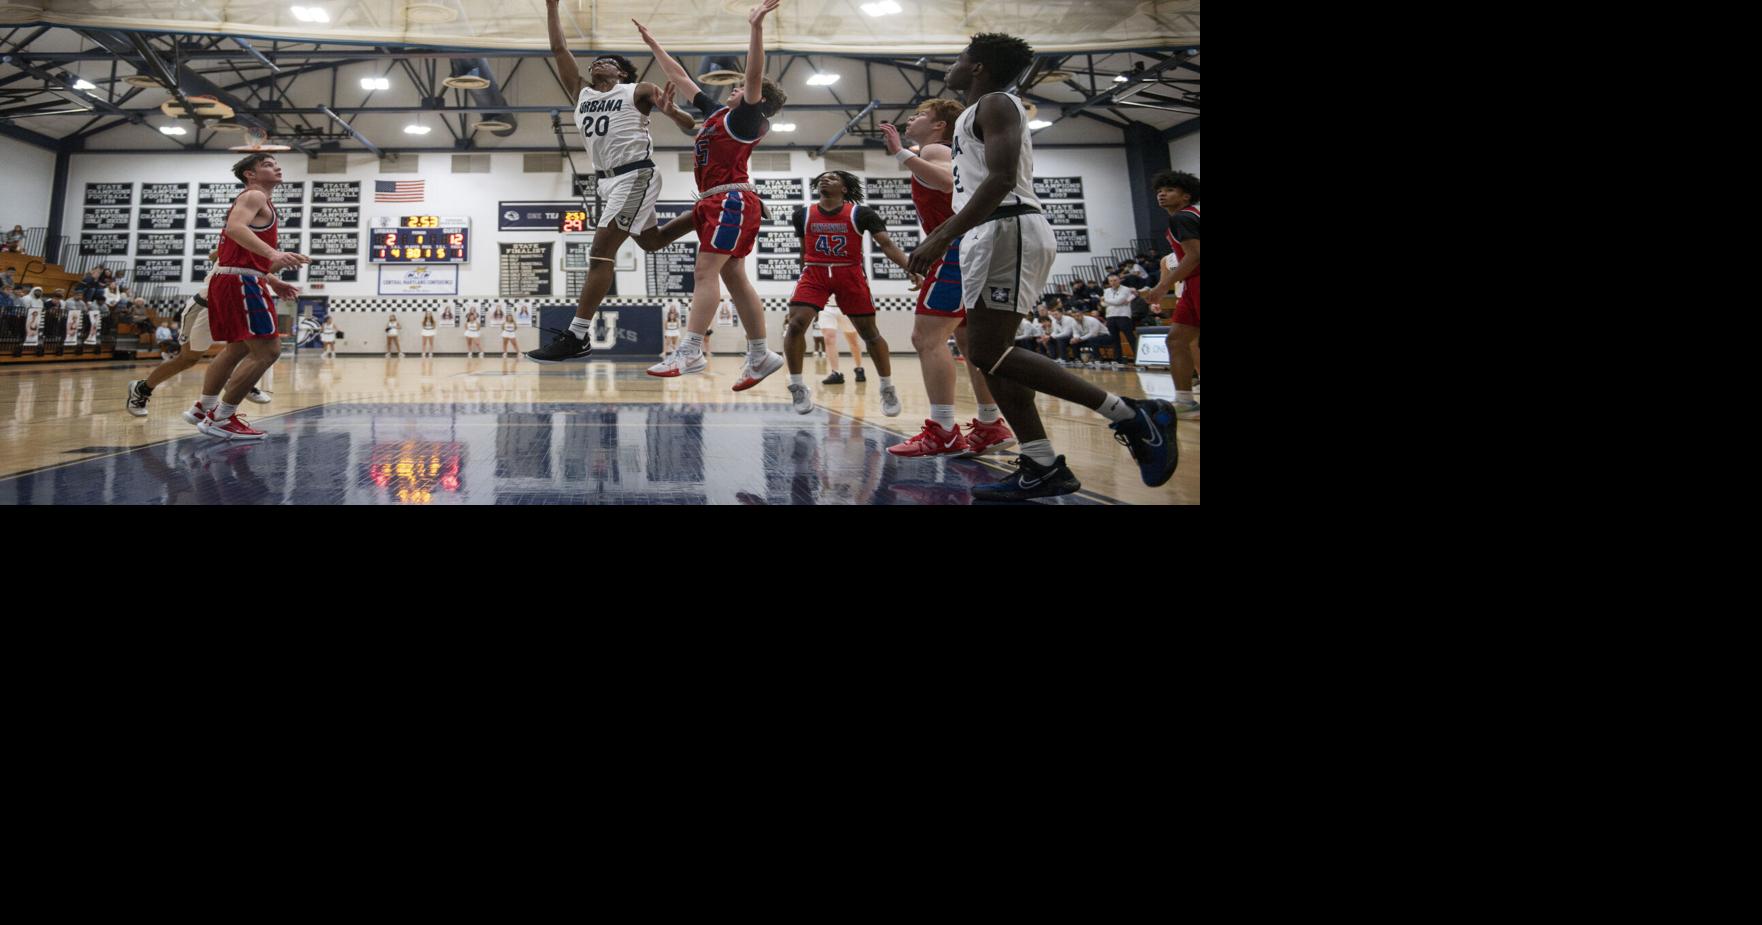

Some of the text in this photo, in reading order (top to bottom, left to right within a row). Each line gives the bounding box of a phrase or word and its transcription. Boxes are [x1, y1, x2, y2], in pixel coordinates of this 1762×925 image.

[579, 99, 624, 114] URBANA
[582, 115, 610, 137] 20
[563, 220, 583, 232] 29
[386, 234, 396, 245] 2
[418, 236, 423, 244] 1
[449, 234, 464, 245] 12
[815, 235, 848, 256] 42
[589, 311, 619, 350] U
